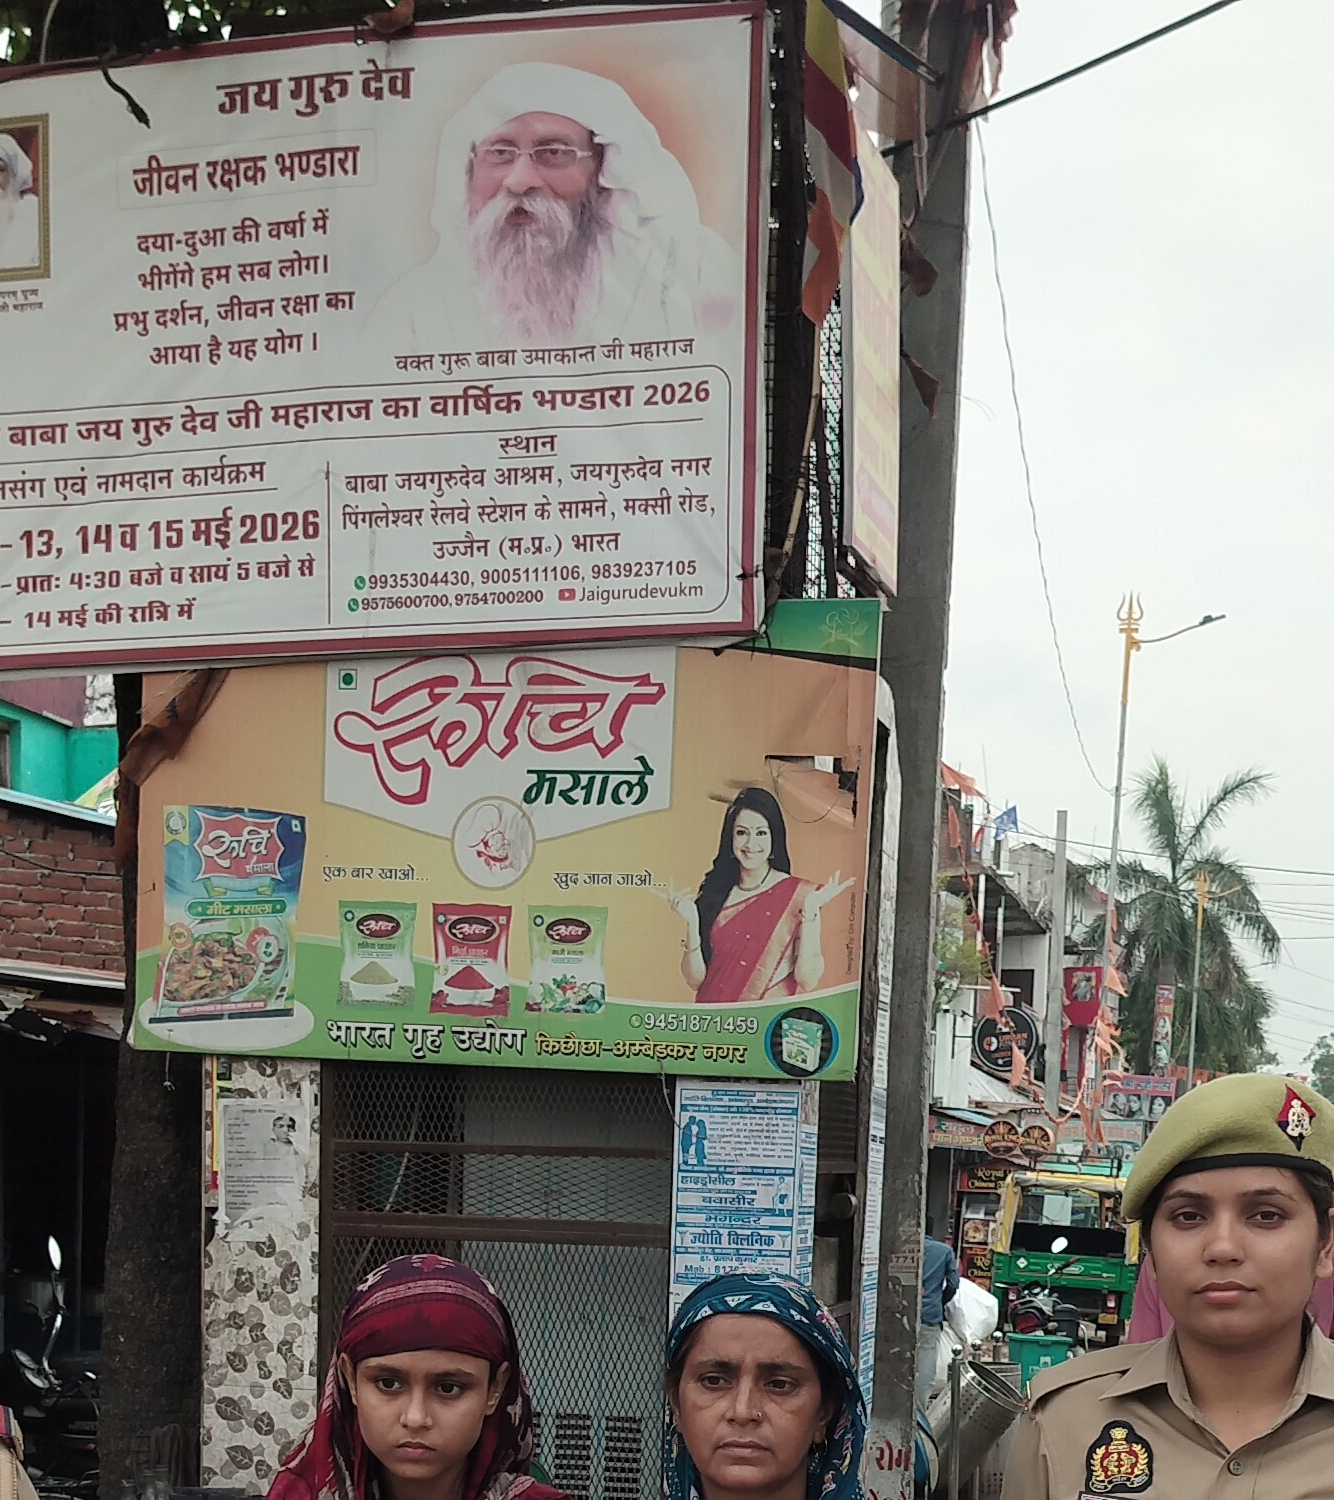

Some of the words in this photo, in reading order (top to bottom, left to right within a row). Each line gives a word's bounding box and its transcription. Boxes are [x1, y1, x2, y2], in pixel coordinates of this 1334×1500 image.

[217, 78, 282, 116] जय
[289, 69, 354, 119] गुरु
[360, 58, 415, 101] देव
[133, 151, 200, 198] जीवन
[205, 153, 267, 193] रक्षक
[274, 143, 361, 182] भण्डारा
[136, 226, 227, 257] दया-दुआ
[231, 217, 262, 247] की
[267, 211, 307, 242] वर्षा
[312, 208, 332, 237] में
[137, 261, 196, 292] भीगेंगे
[201, 264, 231, 288] हम
[238, 260, 272, 284] सब
[113, 308, 151, 337] प्रभु
[217, 294, 274, 324] जीवन
[280, 293, 320, 318] रक्षा
[325, 289, 356, 313] का
[149, 340, 201, 366] आया
[207, 334, 222, 366] है
[228, 335, 258, 361] यह
[264, 328, 303, 355] योग
[394, 353, 434, 373] वक्त
[475, 348, 517, 367] बाबा
[521, 343, 597, 366] उमाकान्त
[600, 337, 624, 361] जी
[629, 337, 695, 361] महाराज
[8, 422, 68, 447] बाबा
[77, 418, 124, 443] जय
[132, 414, 173, 447] गुरु
[181, 405, 219, 434] देव
[227, 400, 263, 430] जी
[271, 398, 374, 429] महाराज
[382, 396, 422, 420] का
[429, 384, 523, 417] वार्षिक
[531, 384, 635, 412] भण्डारा
[642, 379, 711, 408] 2026
[498, 434, 558, 455] स्थान
[54, 466, 88, 502] एवं
[96, 468, 174, 496] नामदान
[181, 454, 267, 488] कार्यक्रम
[345, 473, 388, 495] बाबा
[394, 464, 487, 499] जयगुरुदेव
[494, 464, 563, 489] आश्रम,
[569, 455, 663, 490] जयगुरुदेव
[670, 456, 712, 478] नगर
[341, 502, 424, 531] पिंगलेश्वर
[429, 498, 470, 527] रेलवे
[477, 496, 529, 525] स्टेशन
[534, 494, 551, 521] के
[622, 487, 672, 517] मक्सी
[19, 529, 64, 560] 13,
[76, 523, 112, 555] 14
[118, 522, 140, 552] व
[147, 518, 184, 550] 15
[190, 505, 233, 551] मई
[239, 509, 321, 544] 2026
[432, 530, 491, 561] उज्जैन
[570, 531, 621, 554] भारत
[69, 570, 122, 591] 4:30
[129, 562, 165, 588] बजे
[169, 566, 185, 586] व
[189, 556, 230, 584] सायं
[236, 560, 251, 582] 5
[256, 553, 292, 581] बजे
[297, 552, 316, 578] से
[368, 570, 476, 592] 9935304430,
[480, 565, 586, 586] 9005111106,
[591, 559, 698, 581] 9839237105
[25, 611, 52, 629] 14
[58, 604, 89, 629] मई
[94, 603, 123, 626] की
[128, 600, 171, 625] रात्रि
[176, 596, 198, 621] में
[579, 583, 704, 605] Jaigurudevukm
[522, 755, 655, 808] मसाले
[323, 865, 348, 883] एक
[351, 866, 374, 881] बार
[553, 871, 579, 891] खुद
[582, 872, 613, 887] जान
[326, 1019, 396, 1049] भारत
[403, 1021, 443, 1061] गृह
[451, 1017, 527, 1056] उद्योग
[701, 1041, 748, 1063] नगर
[643, 1012, 759, 1036] 9451871459
